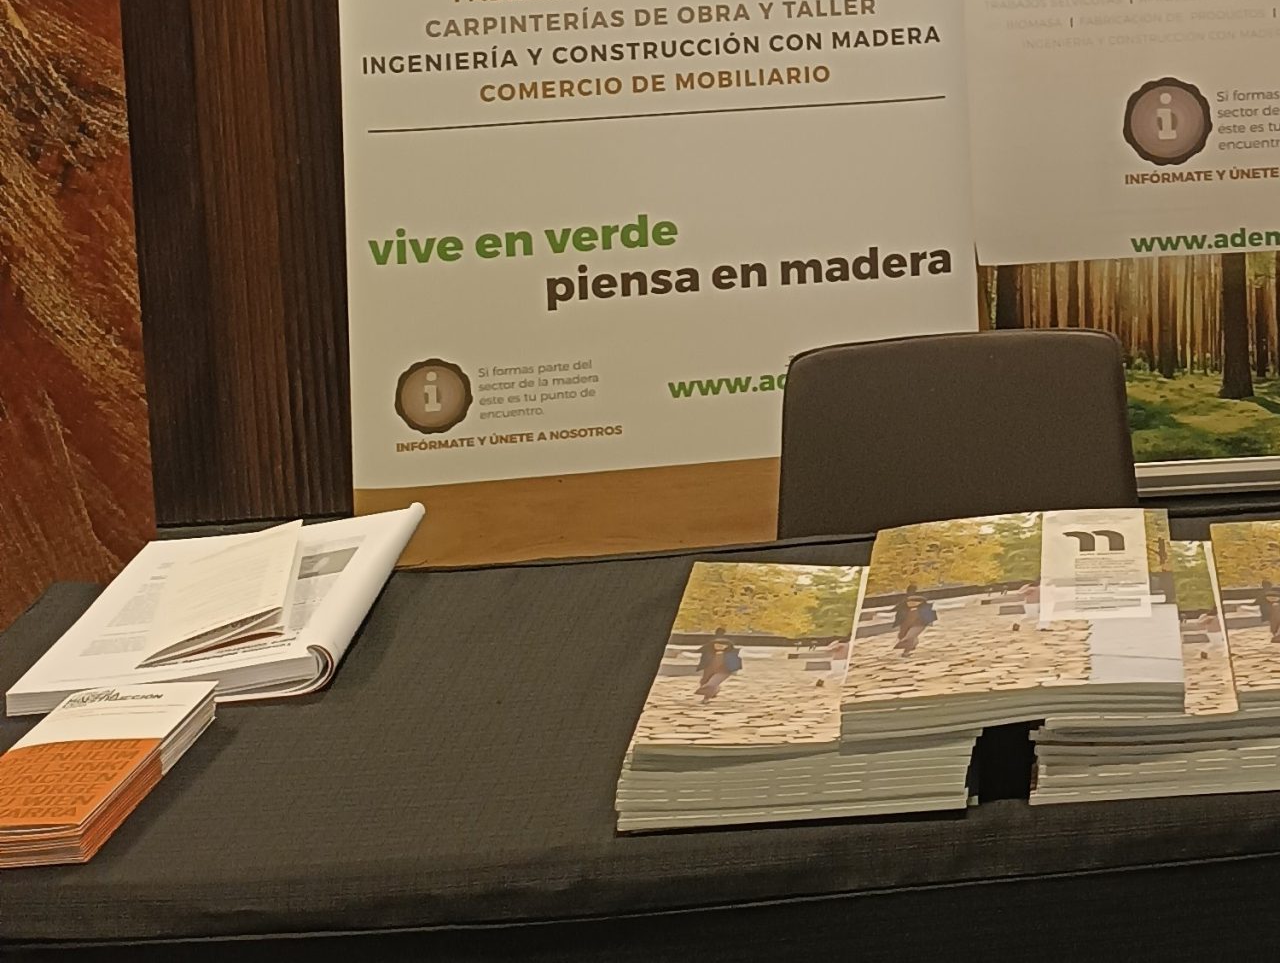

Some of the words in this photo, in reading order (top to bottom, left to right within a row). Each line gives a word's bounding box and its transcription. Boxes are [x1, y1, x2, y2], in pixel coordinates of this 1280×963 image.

[426, 7, 624, 37] CARPINTERÍAS
[635, 8, 668, 26] DE
[677, 4, 750, 23] OBRA
[759, 2, 773, 19] Y
[363, 46, 518, 74] INGENIERÍA
[527, 48, 542, 65] Y
[553, 32, 759, 64] CONSTRUCCIÓN
[769, 33, 821, 52] CON
[832, 26, 940, 49] MADERA
[480, 77, 622, 102] COMERCIO
[632, 75, 665, 93] DE
[676, 66, 830, 90] MOBILIARIO
[1217, 92, 1228, 102] Si
[1233, 90, 1280, 101] formas
[1218, 108, 1259, 118] sector
[1262, 105, 1280, 116] de
[1218, 124, 1246, 134] éste
[1250, 122, 1264, 133] es
[1125, 170, 1212, 184] INFÓRMATE
[1216, 170, 1226, 180] Y
[1229, 167, 1279, 179] ÚNETE
[368, 228, 464, 265] vive
[475, 231, 533, 258] en
[544, 214, 678, 253] verde
[547, 265, 699, 311] piensa
[712, 263, 767, 289] en
[781, 247, 951, 285] madera
[478, 368, 490, 378] Si
[493, 365, 534, 376] formas
[538, 363, 569, 374] parte
[573, 359, 592, 371] del
[478, 380, 515, 392] sector
[519, 379, 534, 389] de
[538, 377, 549, 387] la
[552, 374, 599, 386] madera
[479, 395, 504, 405] éste
[508, 395, 521, 403] es
[524, 392, 537, 402] tu
[540, 391, 577, 403] punto
[580, 388, 596, 398] de
[396, 436, 475, 452] INFÓRMATE
[477, 436, 487, 445] Y
[490, 432, 534, 444] ÚNETE
[537, 432, 547, 441] A
[550, 425, 623, 440] NOSOTROS
